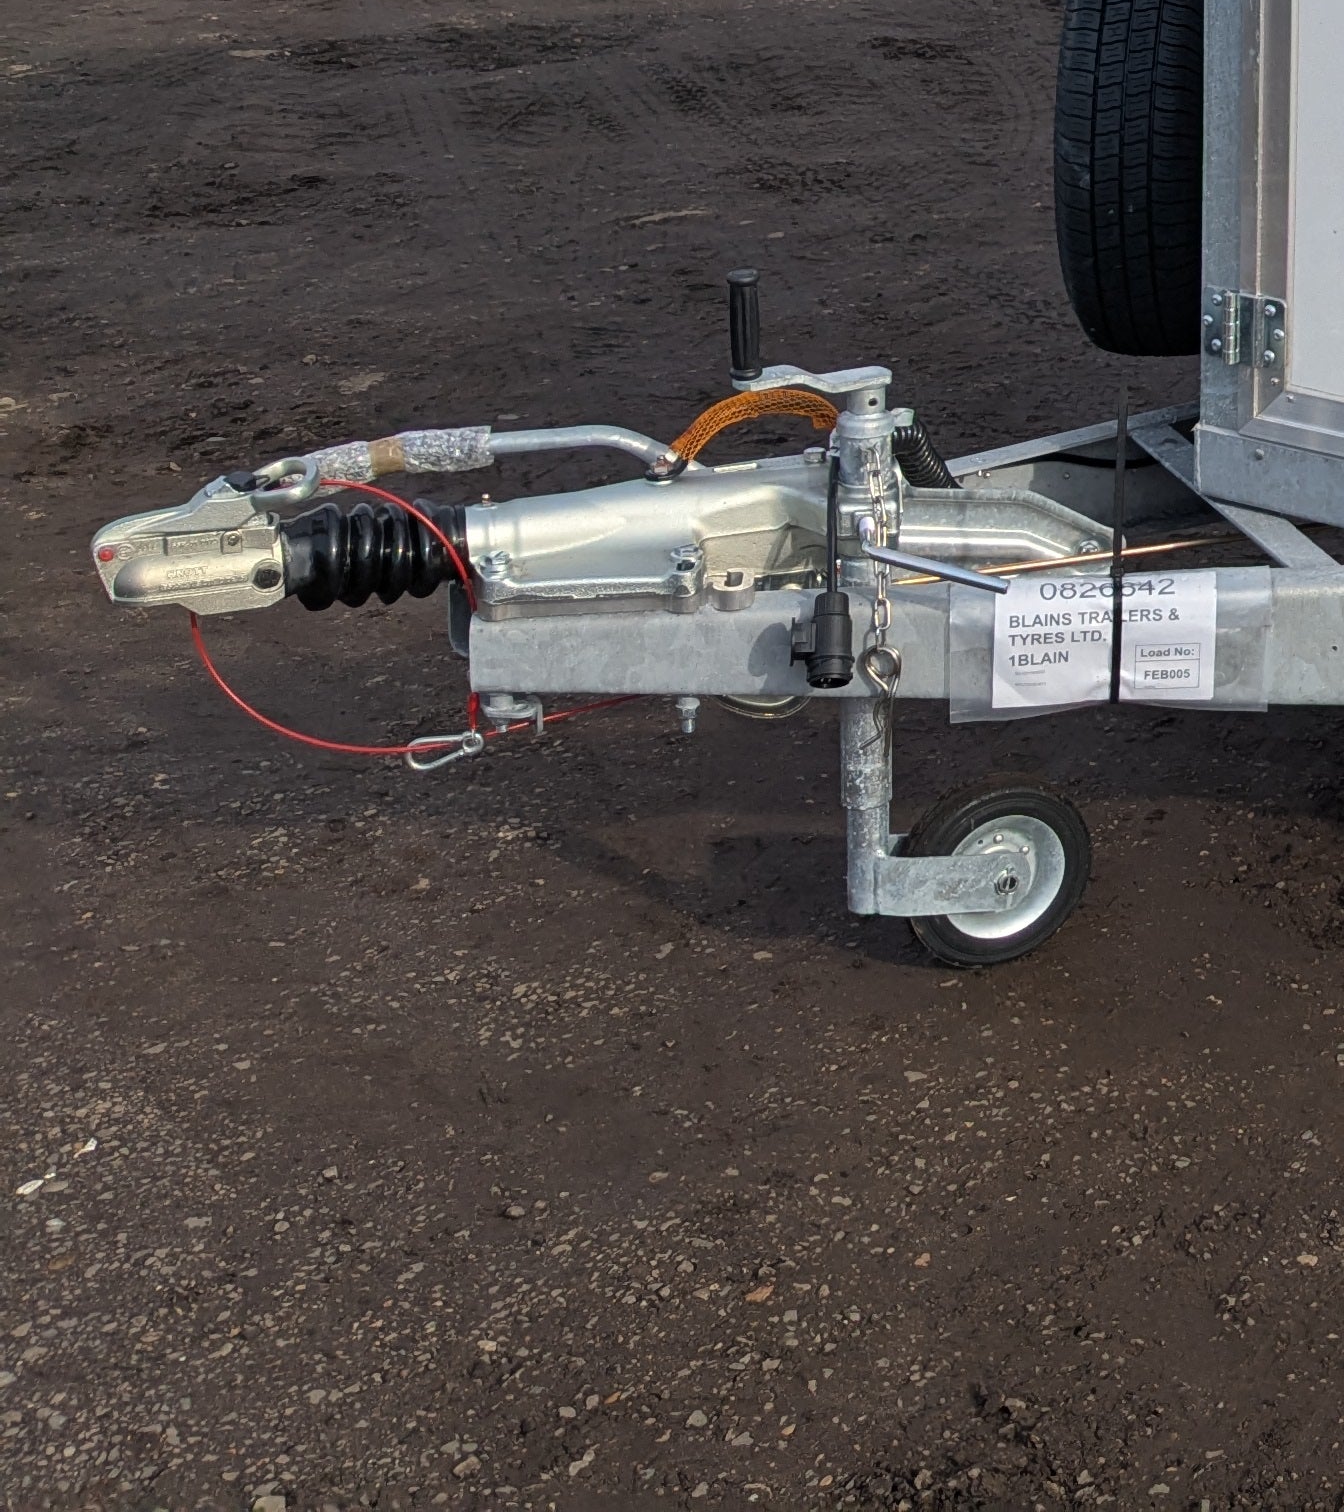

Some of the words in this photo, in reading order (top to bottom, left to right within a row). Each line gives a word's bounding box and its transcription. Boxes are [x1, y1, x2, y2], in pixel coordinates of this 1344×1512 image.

[1009, 612, 1072, 629] BLAINS
[1168, 608, 1180, 621] &
[1008, 631, 1065, 647] TYRES
[1071, 629, 1107, 643] LTD.
[1008, 650, 1069, 667] 1BLAIN
[1141, 647, 1171, 658] Load
[1174, 646, 1195, 657] No:
[1144, 668, 1191, 681] FEB005
